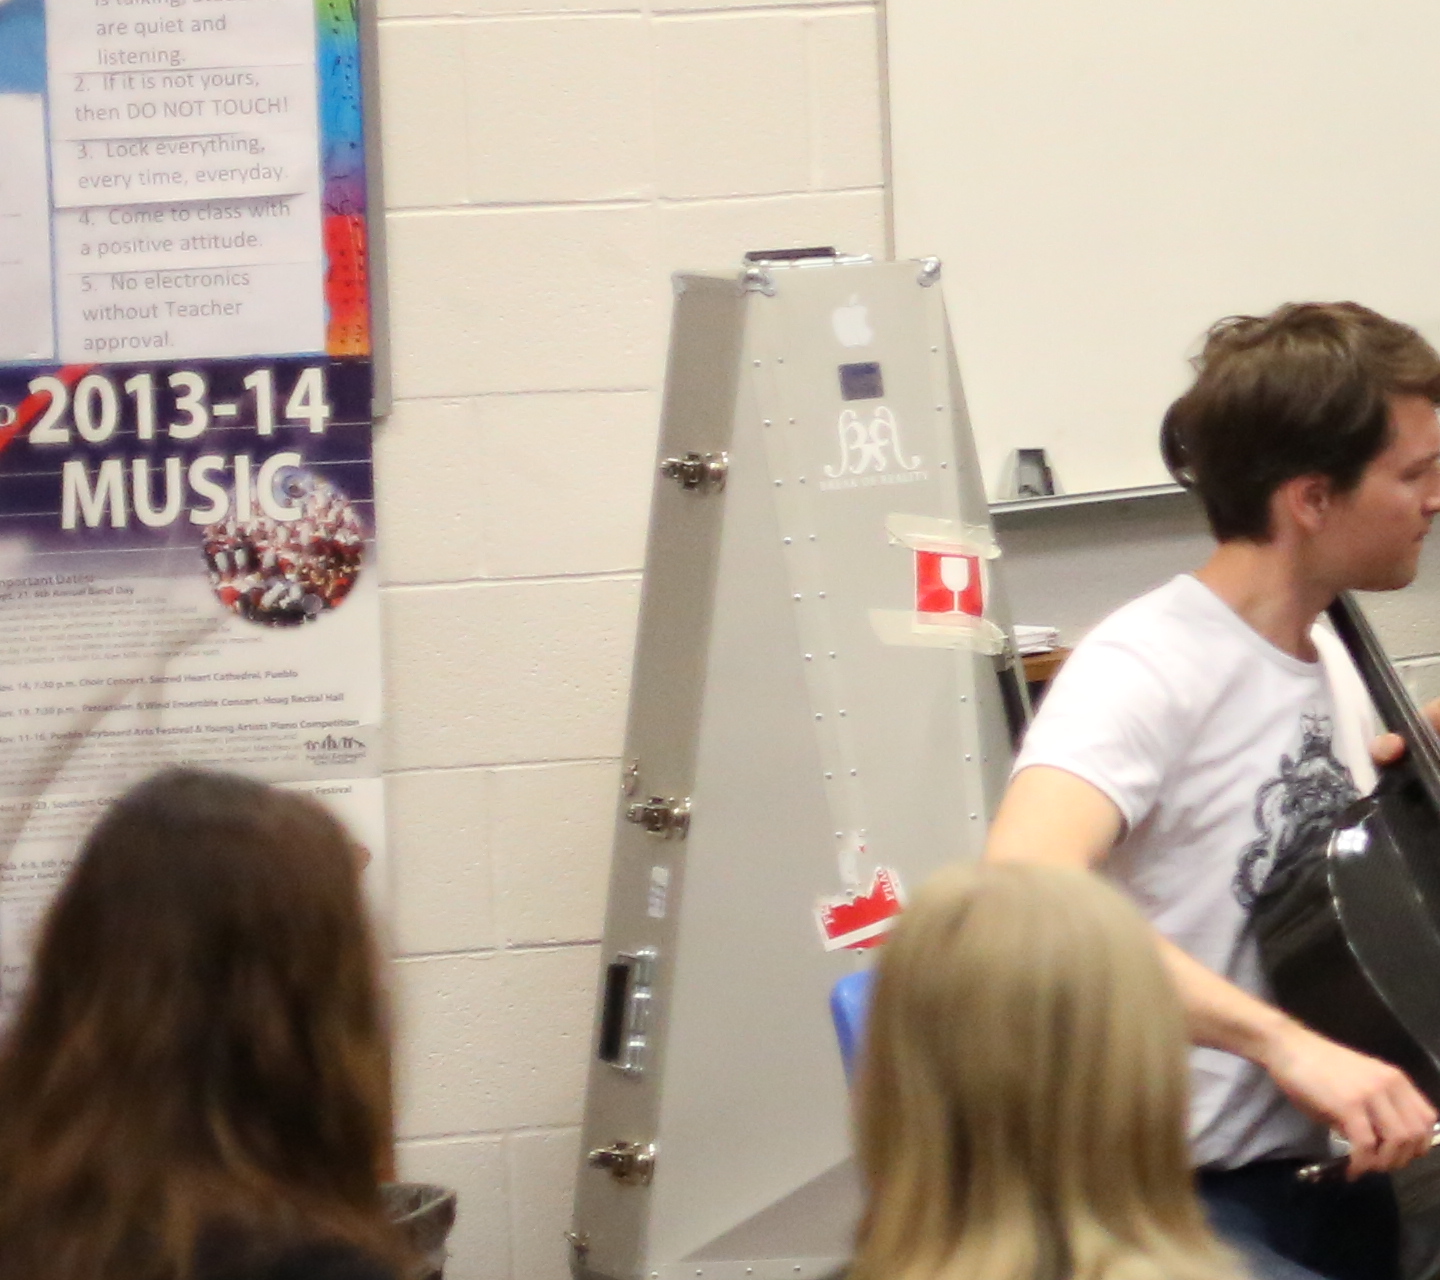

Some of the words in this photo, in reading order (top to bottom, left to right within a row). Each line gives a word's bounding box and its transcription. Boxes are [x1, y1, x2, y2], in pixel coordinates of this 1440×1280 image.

[97, 22, 128, 36] are
[134, 18, 184, 37] quiet
[191, 15, 227, 31] and
[97, 48, 186, 67] listening.
[122, 73, 135, 90] it
[142, 74, 155, 89] is
[162, 73, 194, 89] not
[75, 104, 119, 122] then
[127, 102, 156, 120] DO
[164, 100, 205, 118] NOT
[211, 97, 289, 116] TOUCH!
[106, 139, 149, 158] Lock
[79, 173, 132, 189] every
[108, 208, 164, 225] Come
[171, 206, 191, 222] to
[197, 202, 242, 220] class
[250, 200, 290, 218] with
[80, 242, 91, 256] a
[97, 237, 174, 259] positive
[111, 273, 138, 291] No
[144, 270, 250, 290] electronics
[82, 303, 159, 321] without
[164, 299, 243, 318] Teacher
[83, 330, 175, 353] approval.
[28, 367, 331, 444] 2013-14
[61, 451, 303, 530] MUSIC
